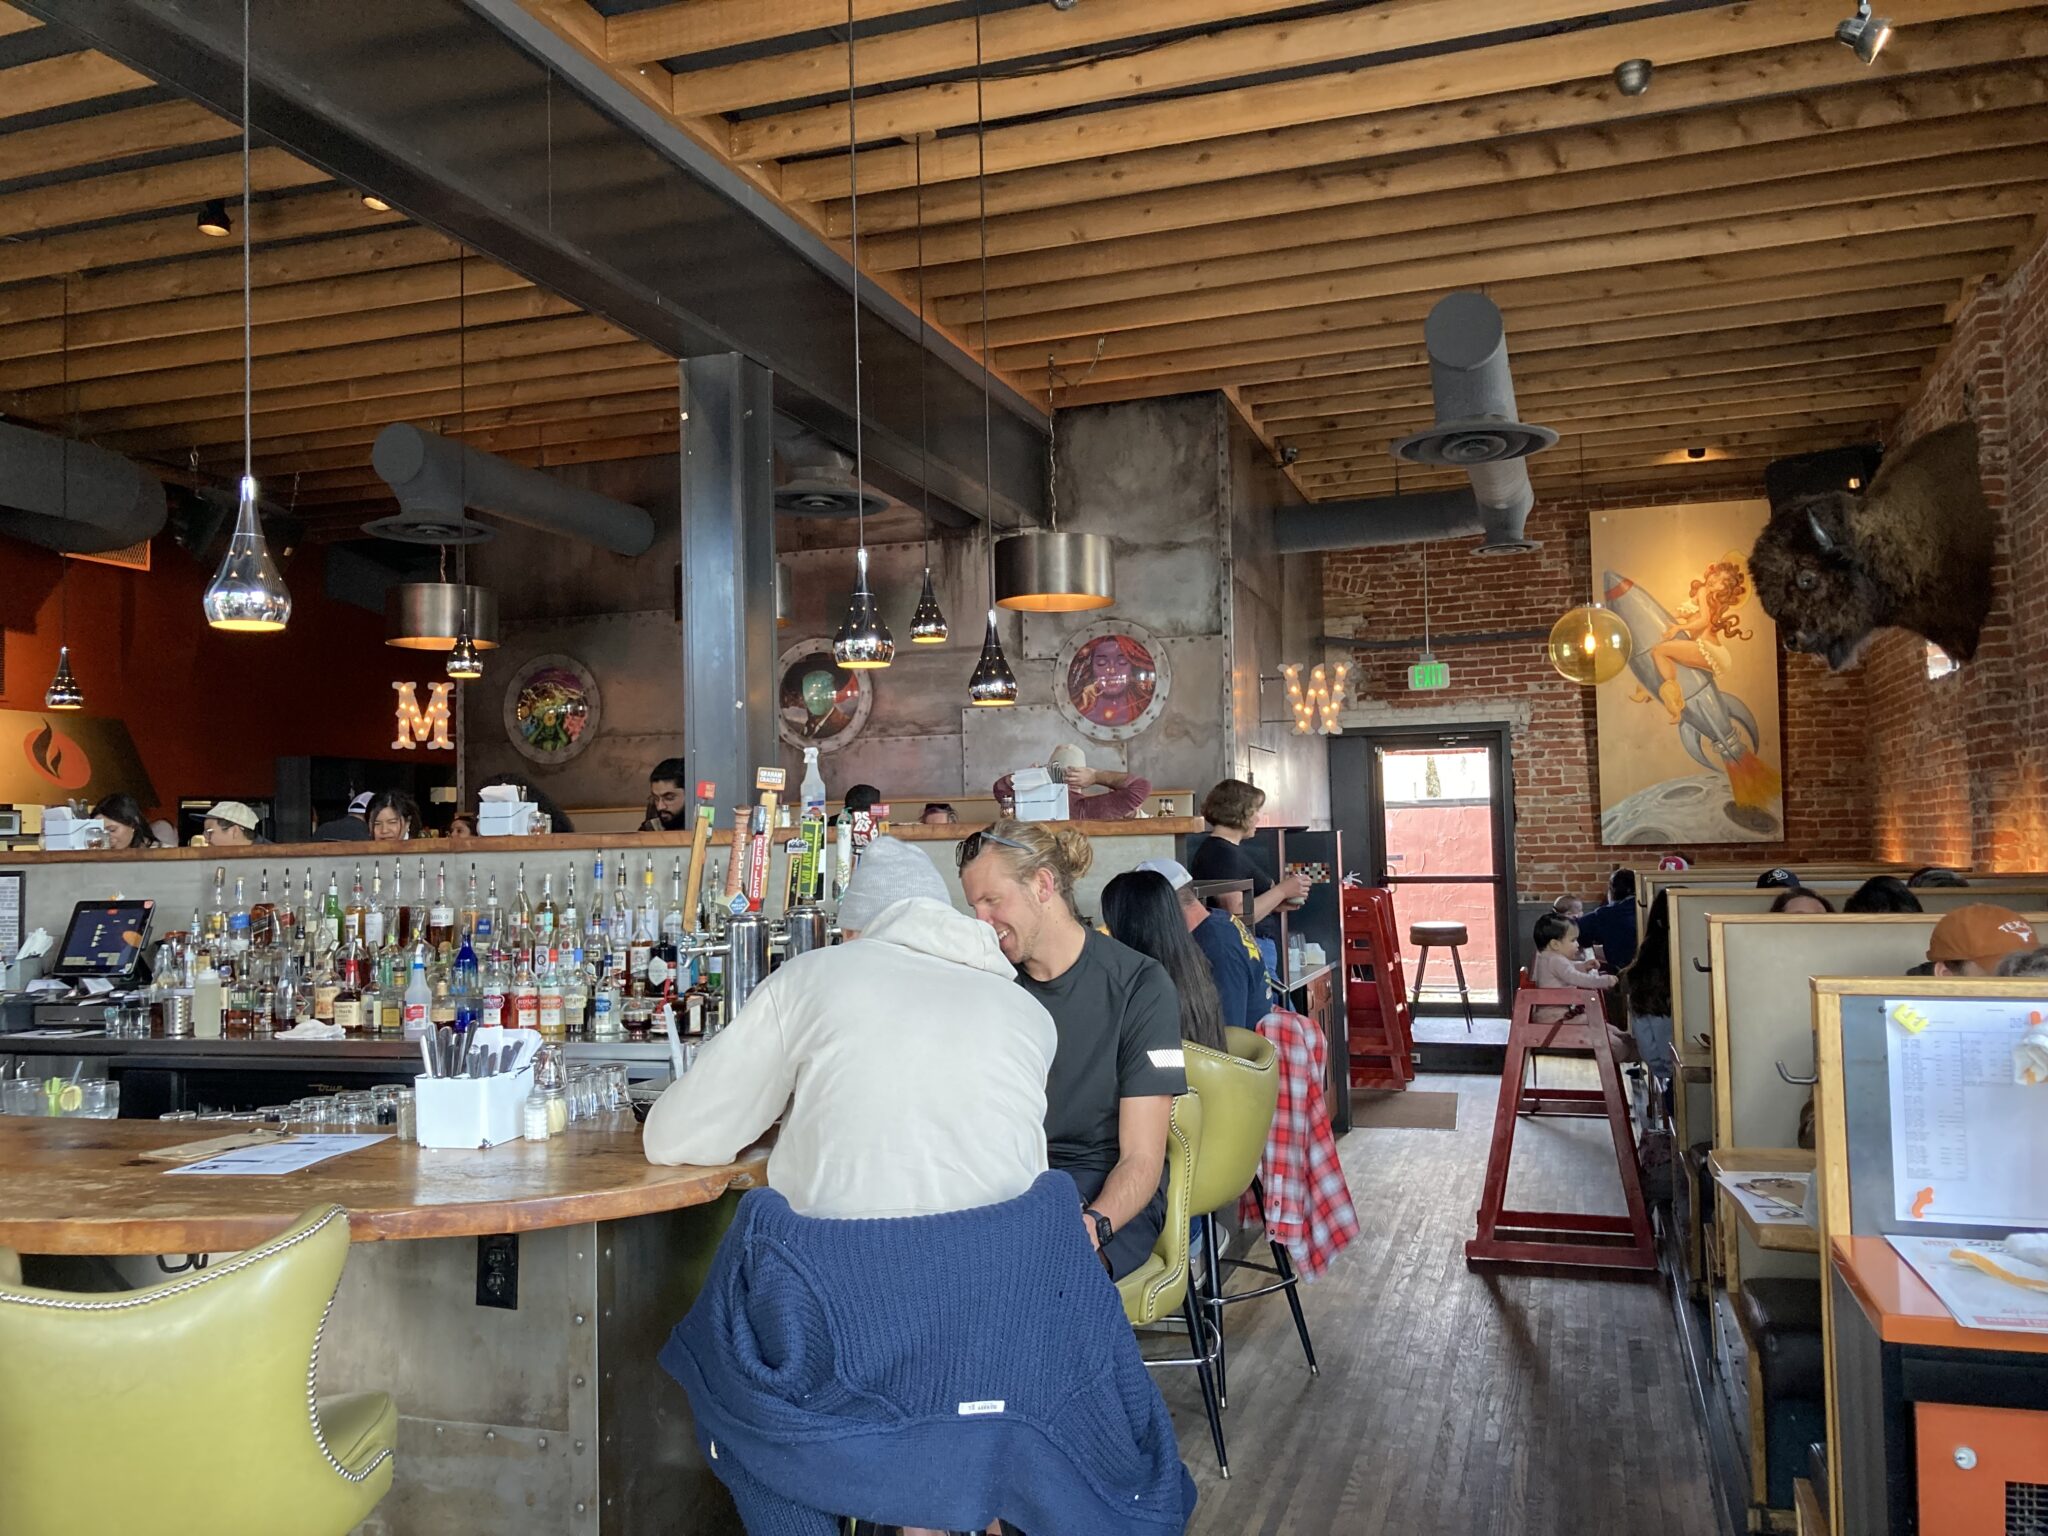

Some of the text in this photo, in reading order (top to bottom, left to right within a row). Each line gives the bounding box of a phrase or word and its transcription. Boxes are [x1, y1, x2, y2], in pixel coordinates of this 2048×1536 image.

[1414, 664, 1444, 688] EXIT
[391, 681, 455, 750] M
[738, 833, 747, 887] TIVOLI
